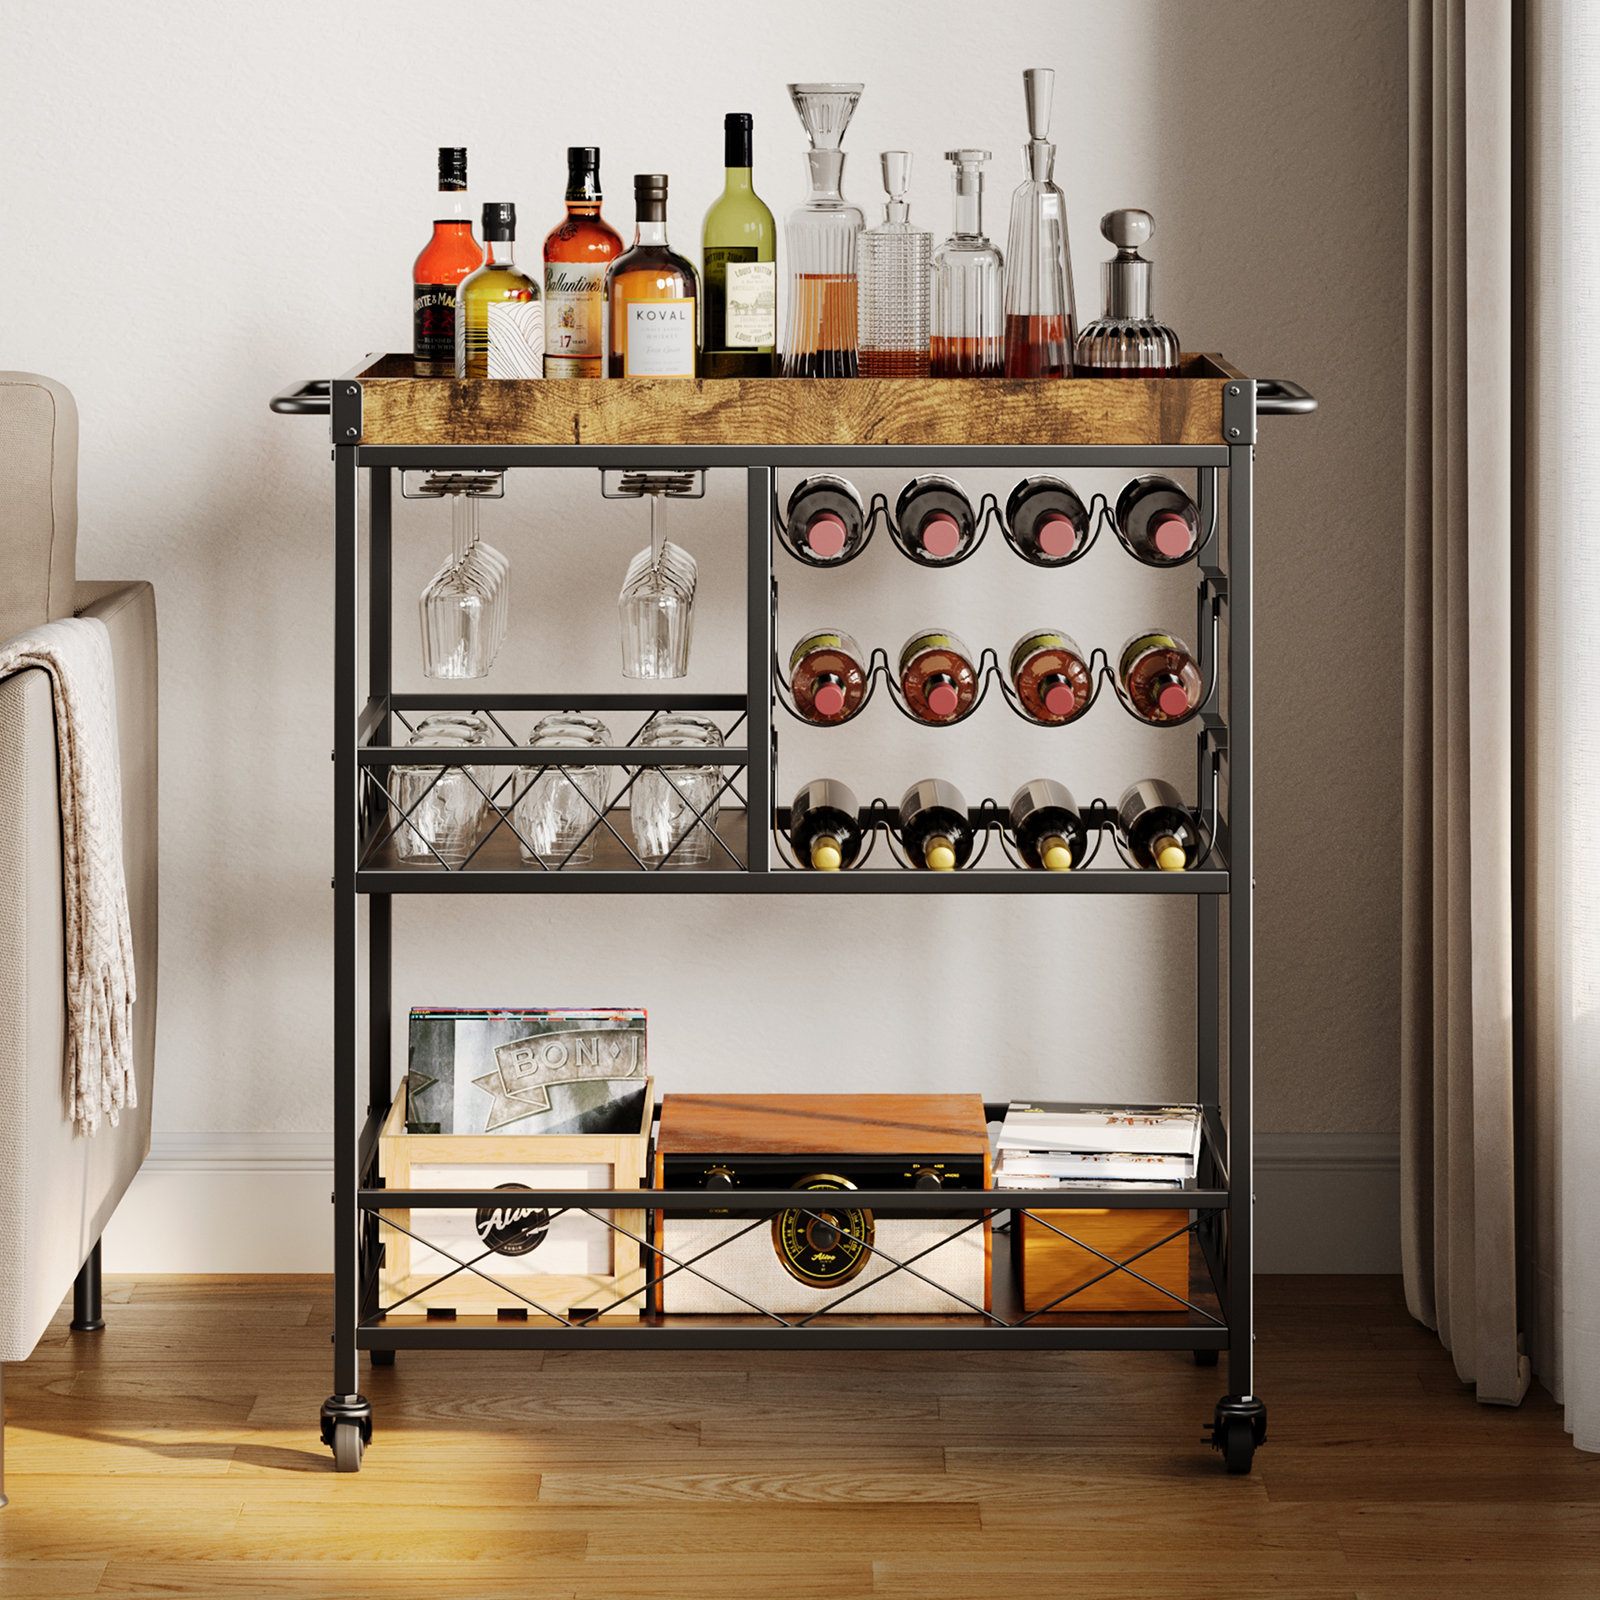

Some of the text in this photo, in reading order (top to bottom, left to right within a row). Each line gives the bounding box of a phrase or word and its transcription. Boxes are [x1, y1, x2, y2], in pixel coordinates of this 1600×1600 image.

[545, 267, 601, 293] Ballantine's
[636, 310, 686, 321] KOVAL
[560, 335, 572, 348] 17
[510, 1036, 599, 1080] BON
